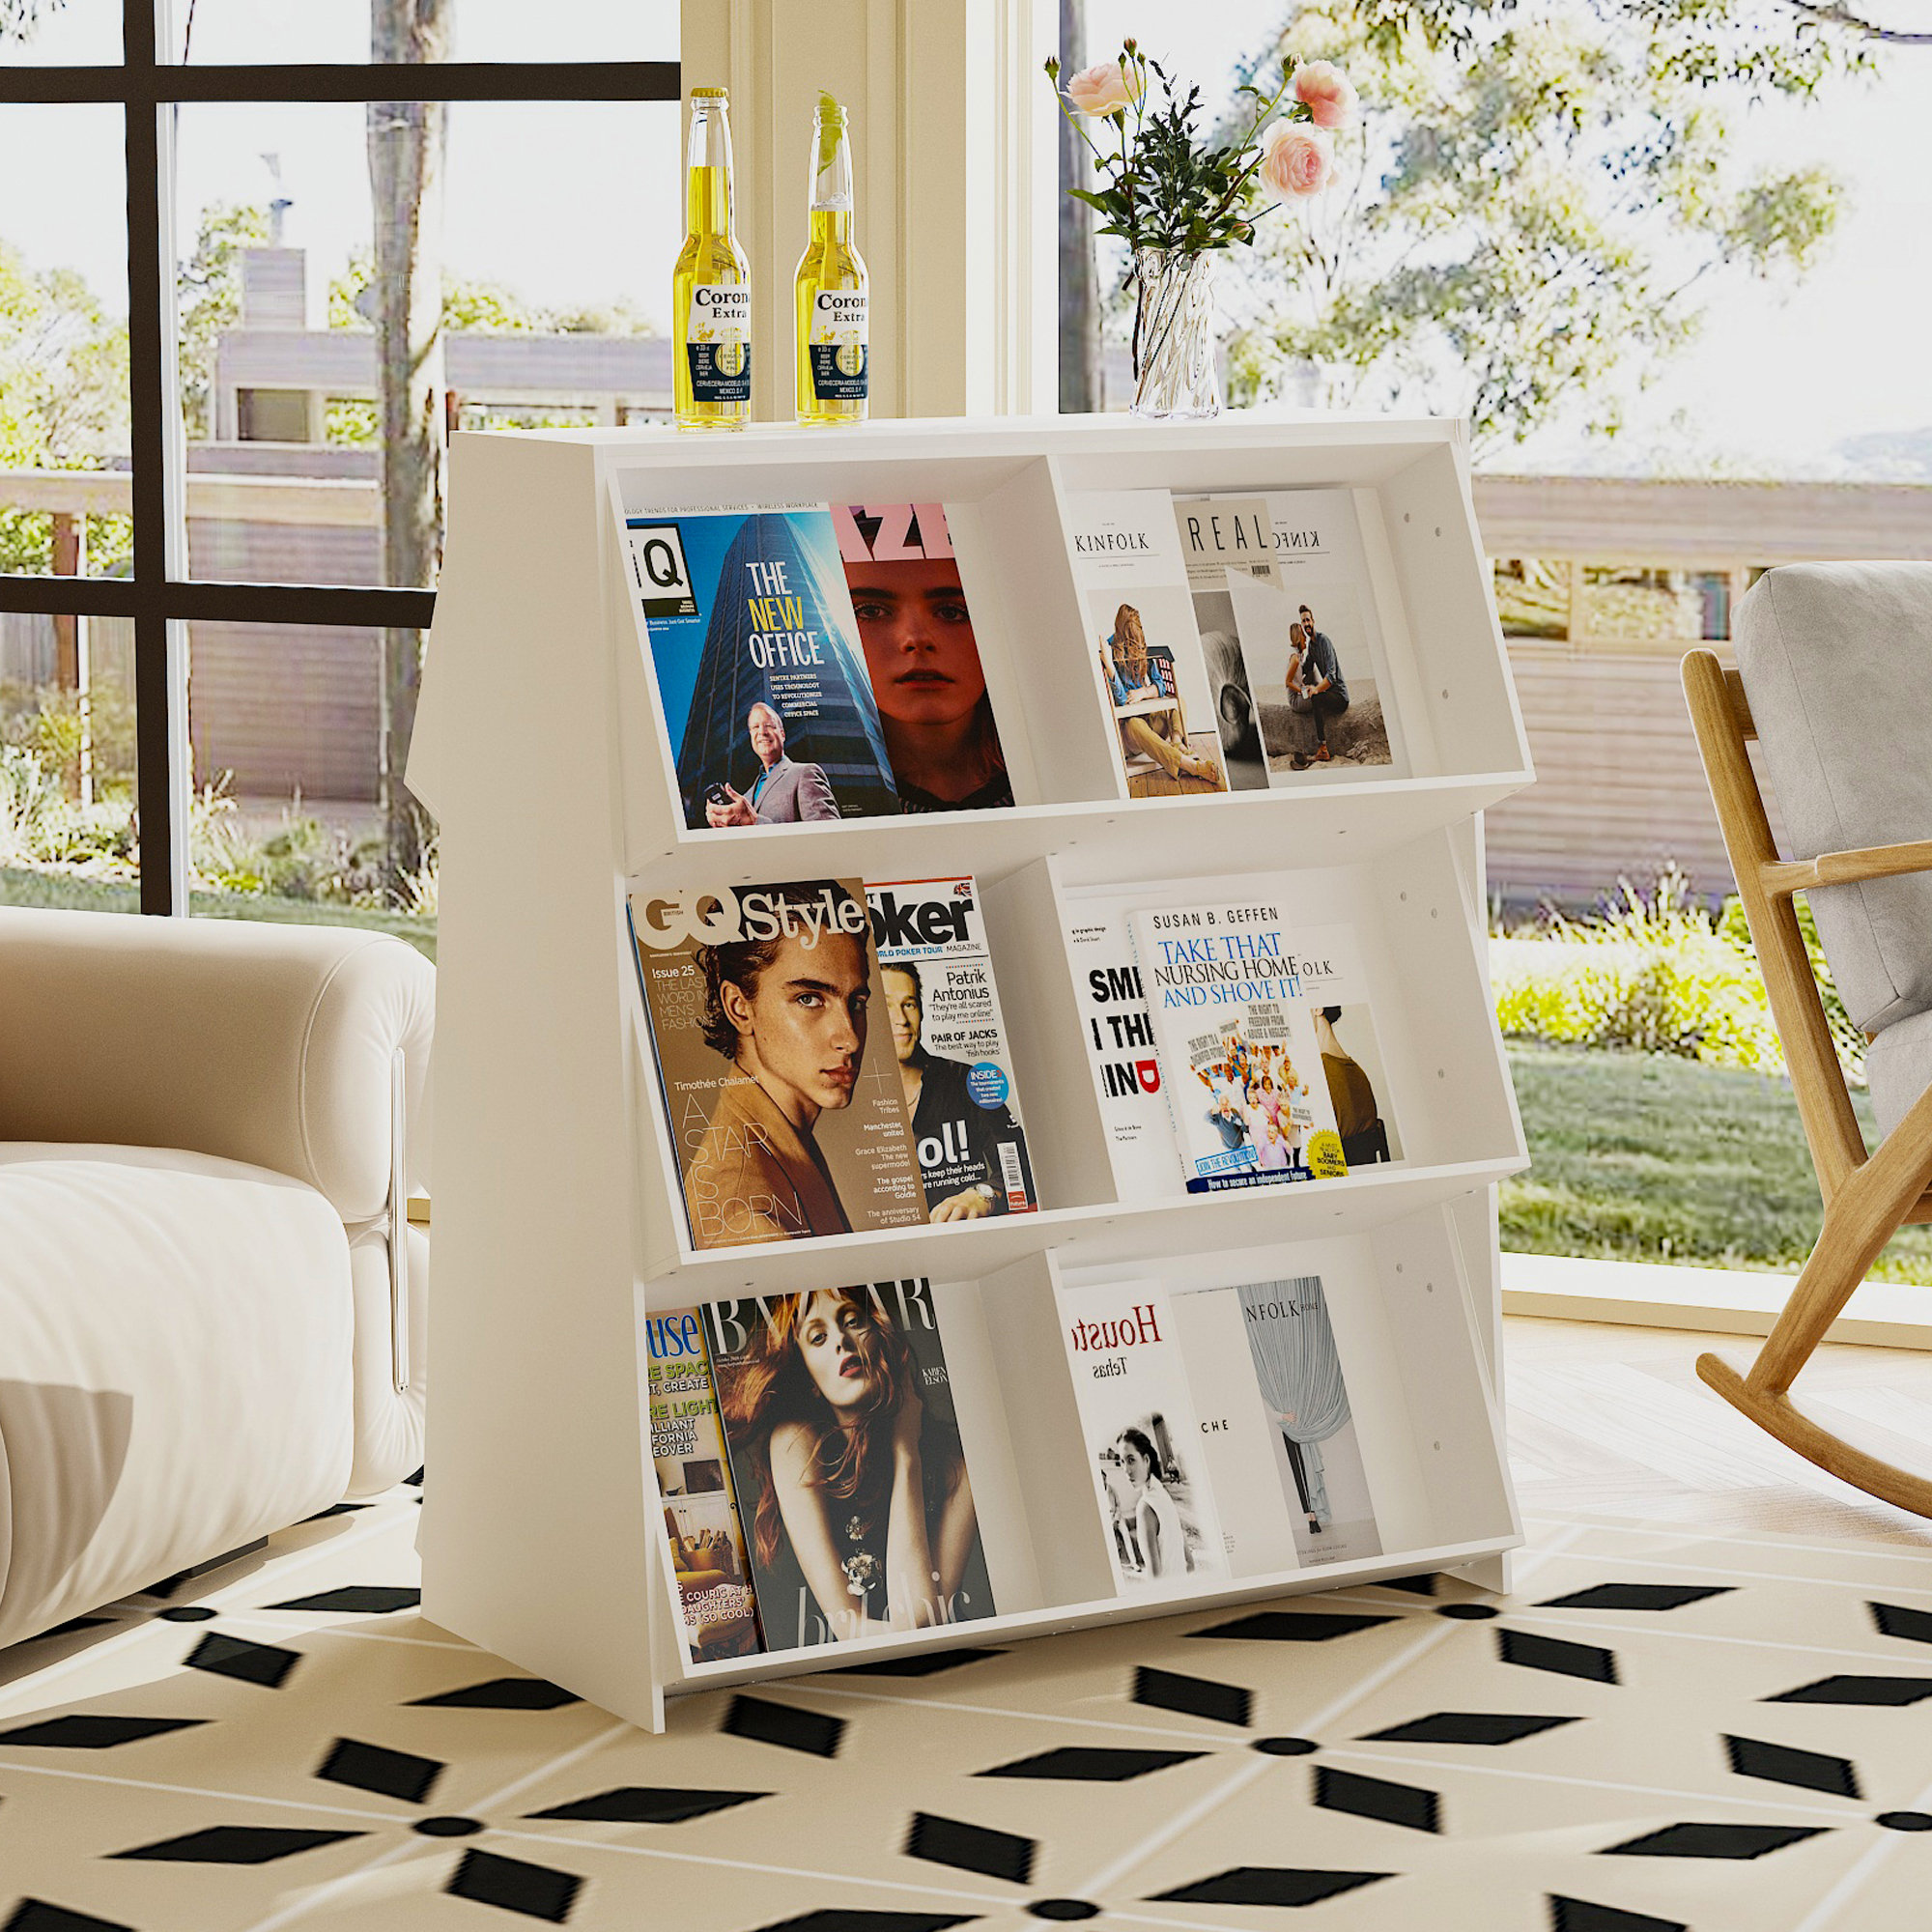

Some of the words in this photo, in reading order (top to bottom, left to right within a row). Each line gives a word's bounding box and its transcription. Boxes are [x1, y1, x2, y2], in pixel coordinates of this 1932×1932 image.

[696, 288, 750, 306] Coron
[679, 504, 721, 513] PROFESSIONAL
[1187, 514, 1267, 552] REAL
[1075, 533, 1150, 552] KINFOLK
[643, 539, 684, 587] Q
[746, 561, 792, 596] THE
[748, 596, 804, 631] NEW
[749, 631, 824, 668] OFFICE
[631, 886, 747, 950] GQ
[741, 889, 866, 950] Style
[1153, 913, 1201, 929] SUSAN
[1208, 911, 1222, 925] B.
[1227, 907, 1278, 923] GEFFEN
[895, 948, 922, 956] POKER
[923, 946, 943, 954] TOUR
[946, 942, 982, 953] MAGAZINE
[1158, 937, 1218, 964] TAKE
[1220, 932, 1281, 959] THAT
[652, 968, 679, 979] Issue
[681, 965, 695, 977] 25
[947, 968, 987, 985] Patrik
[1154, 961, 1239, 986] NURSING
[1243, 956, 1299, 980] HOME
[1303, 960, 1334, 977] OLK
[654, 979, 678, 992] THE
[1164, 985, 1208, 1009] AND
[1210, 980, 1276, 1005] SHOVE
[1280, 974, 1304, 999] IT!
[657, 990, 696, 1004] WORD
[932, 986, 990, 1002] Antonius
[958, 1001, 968, 1009] all
[968, 1000, 992, 1009] scared
[662, 1015, 711, 1031] FASHION
[932, 1013, 941, 1022] to
[942, 1012, 956, 1023] play
[930, 1032, 952, 1043] PAIR
[953, 1031, 966, 1041] OF
[969, 1029, 998, 1040] JACKS
[682, 1093, 711, 1128] A
[872, 1098, 898, 1107] Fashion
[883, 1128, 904, 1137] united
[684, 1122, 772, 1164] STAR
[855, 1147, 875, 1155] Grace
[876, 1144, 907, 1153] Elizabeth
[871, 1159, 911, 1171] supermodel
[1317, 1157, 1345, 1167] BOOMERS
[928, 1170, 946, 1180] keep
[946, 1166, 963, 1177] their
[963, 1162, 985, 1173] heads
[690, 1165, 720, 1200] IS
[891, 1174, 914, 1186] gospel
[933, 1178, 960, 1188] running
[1208, 1179, 1222, 1189] How
[1222, 1179, 1229, 1188] to
[1229, 1178, 1248, 1187] secure
[1248, 1177, 1256, 1185] an
[1256, 1172, 1291, 1186] independent
[873, 1183, 907, 1194] according
[696, 1190, 803, 1237] BORN
[881, 1206, 920, 1217] anniversary
[889, 1214, 911, 1224] Studio
[1246, 1300, 1299, 1322] NFOLK
[646, 1314, 700, 1358] use
[664, 1378, 708, 1393] CREATE
[672, 1398, 718, 1417] LIGHT
[1201, 1420, 1229, 1434] CHE
[652, 1432, 697, 1446] FORNIA
[653, 1442, 694, 1458] EOVER
[686, 1586, 727, 1602] COURIC
[729, 1585, 743, 1597] AT
